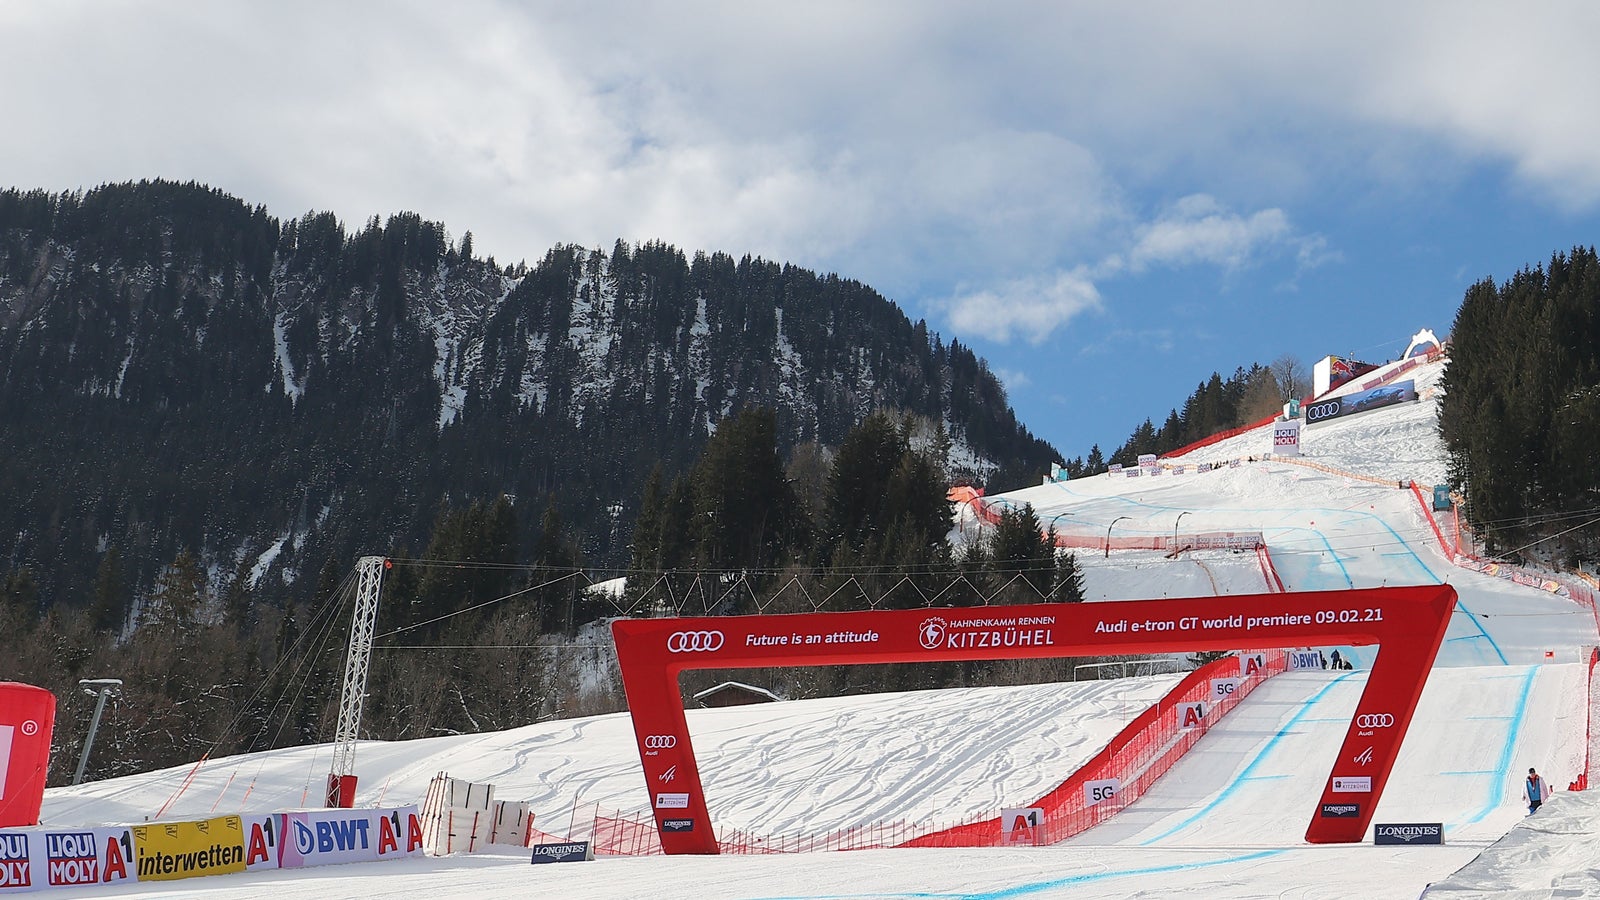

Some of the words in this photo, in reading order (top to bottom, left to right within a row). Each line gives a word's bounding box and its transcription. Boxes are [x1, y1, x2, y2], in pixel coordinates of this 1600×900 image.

[1274, 429, 1296, 438] LIQUI
[1274, 437, 1296, 445] MOLY
[950, 618, 1016, 628] HAHNENKAMM
[1018, 617, 1056, 626] RENNEN
[1095, 620, 1127, 633] Audi
[1131, 619, 1175, 632] e-tron
[1179, 617, 1198, 630] GT
[1202, 615, 1243, 628] world
[1247, 612, 1311, 630] premiere
[1315, 608, 1383, 624] 09.02.21
[746, 634, 788, 646] Future
[791, 633, 802, 645] is
[805, 634, 821, 644] an
[825, 630, 879, 644] attitude
[947, 627, 1054, 649] KITZBÜHEL
[1246, 655, 1263, 675] A1
[1300, 652, 1319, 668] BWT
[1217, 683, 1234, 695] 5G
[1183, 704, 1203, 727] A1
[1093, 786, 1114, 801] 5G
[379, 810, 402, 855] A1
[407, 813, 424, 853] A
[664, 820, 691, 828] LONGINES
[1010, 811, 1037, 842] A1
[1378, 826, 1439, 836] LONGINES
[48, 834, 95, 858] LIQUI
[246, 817, 275, 866] A1
[316, 818, 370, 853] BWT
[103, 830, 133, 882] A1
[138, 844, 243, 876] interwetten
[535, 844, 586, 856] LONGINES
[50, 859, 97, 884] MOLY
